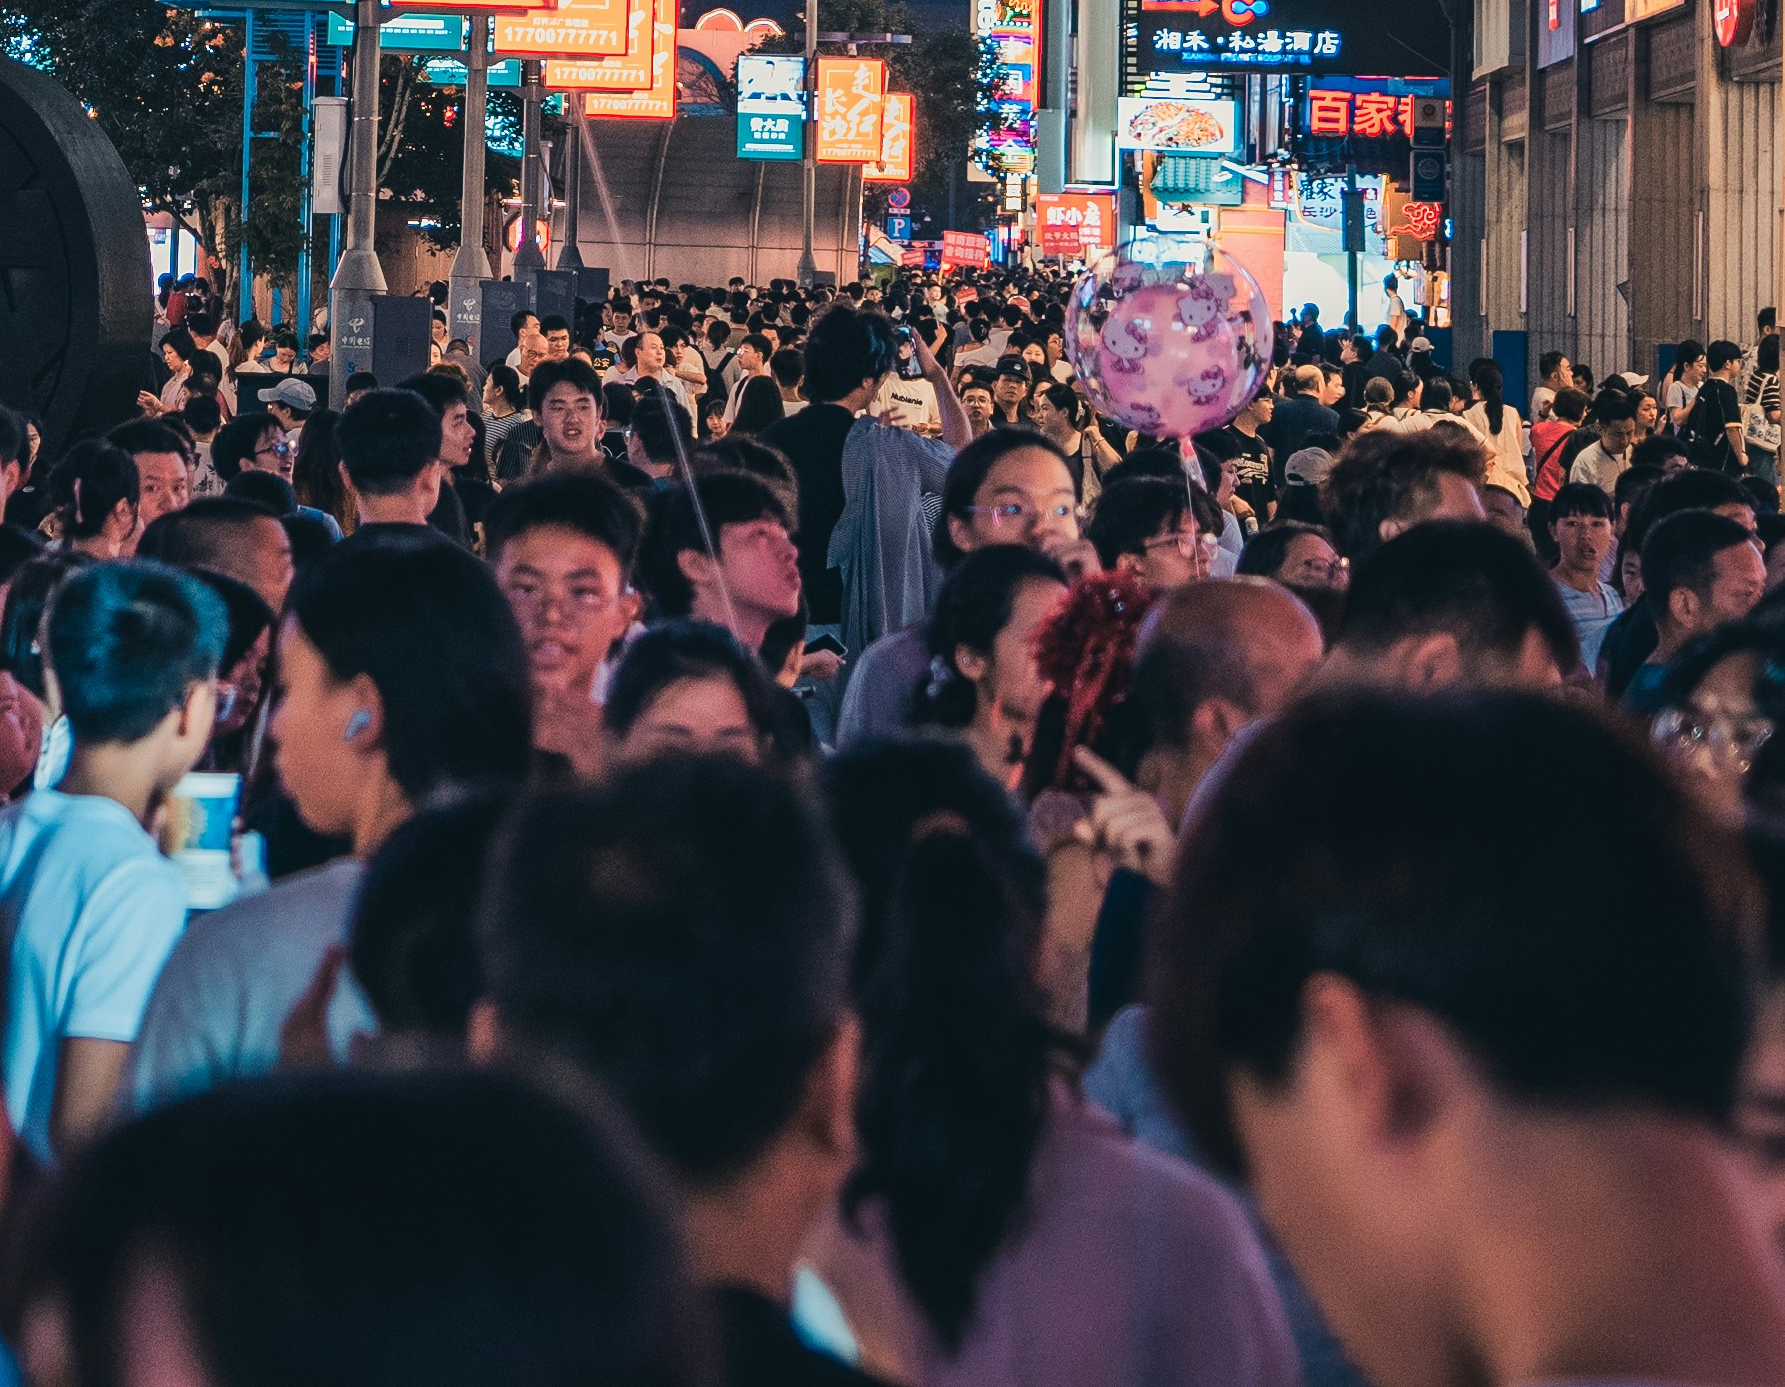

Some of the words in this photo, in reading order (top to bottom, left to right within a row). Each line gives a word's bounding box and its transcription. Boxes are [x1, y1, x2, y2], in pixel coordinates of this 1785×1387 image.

[504, 27, 617, 46] 17700777771
[1301, 206, 1377, 220] 长沙色
[892, 218, 906, 237] P
